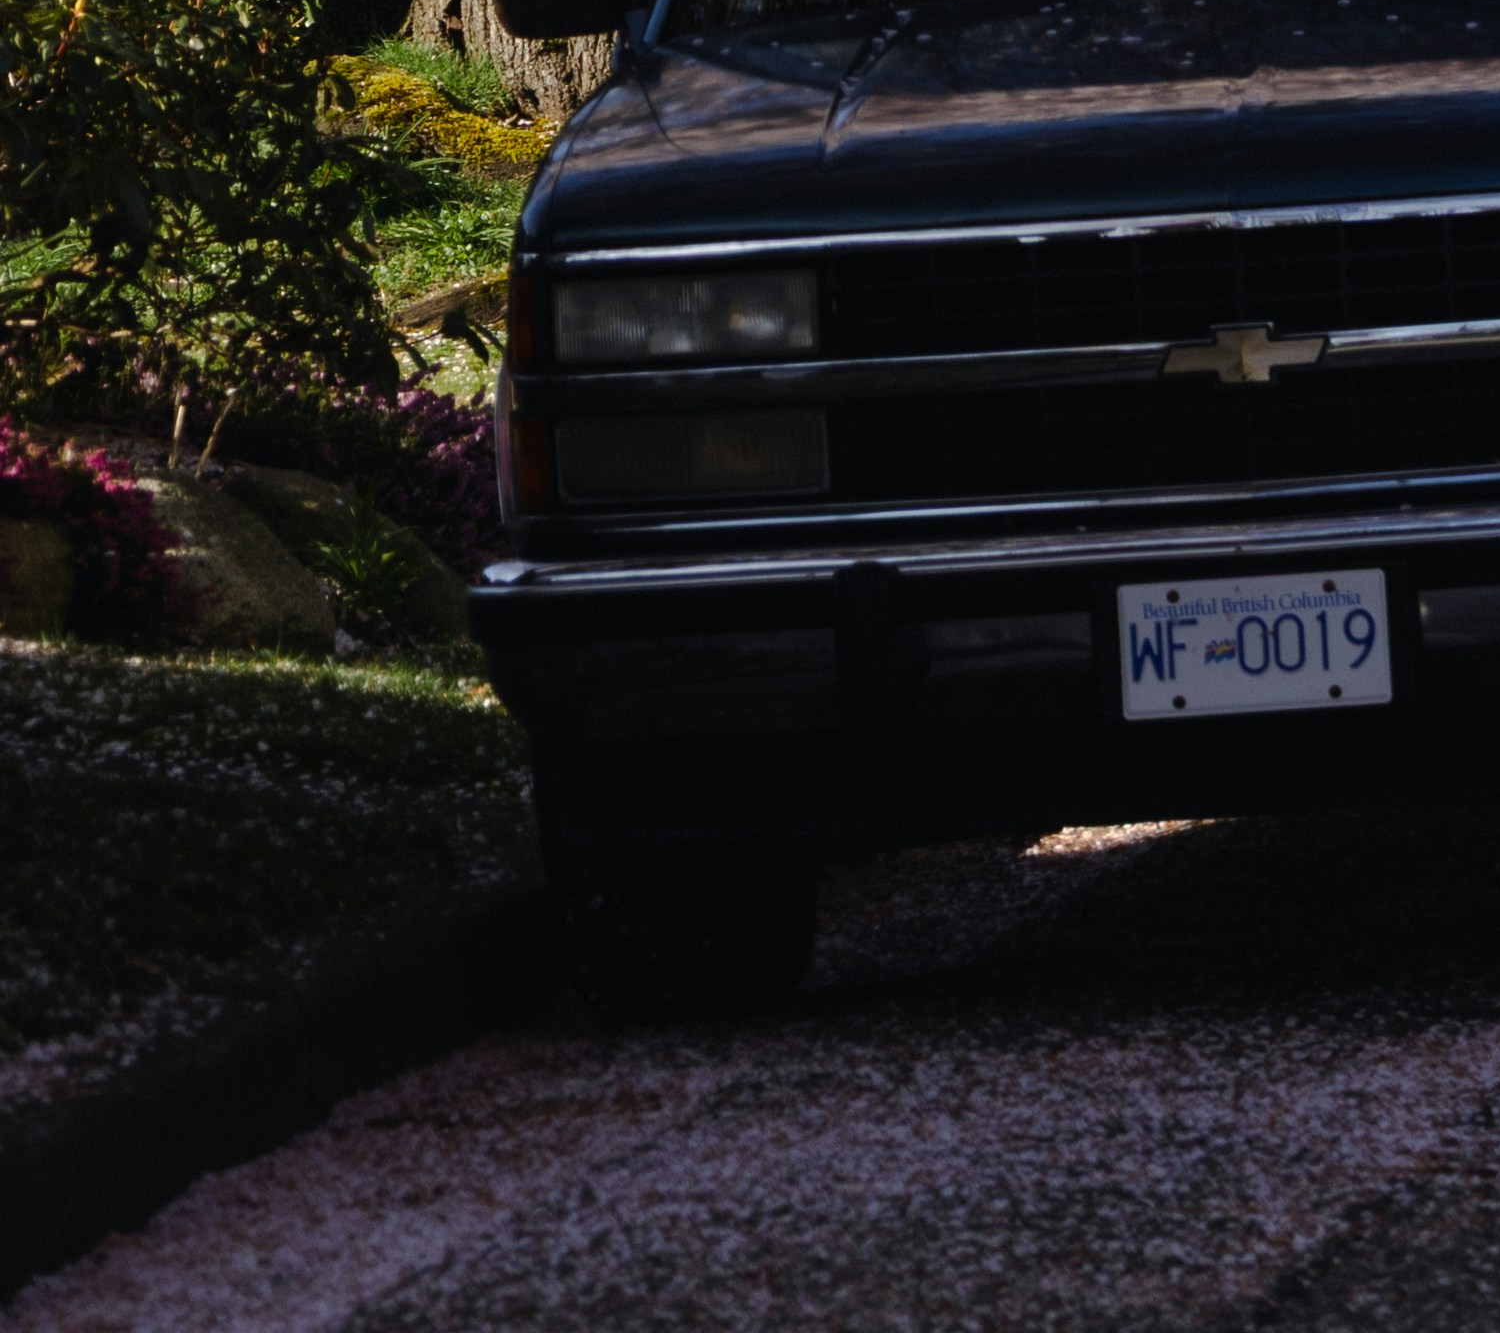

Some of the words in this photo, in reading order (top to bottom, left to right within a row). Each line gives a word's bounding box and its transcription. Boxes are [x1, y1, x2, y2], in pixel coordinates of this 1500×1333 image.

[1142, 597, 1217, 620] Beautiful
[1221, 595, 1276, 614] British
[1278, 588, 1361, 610] Columbia
